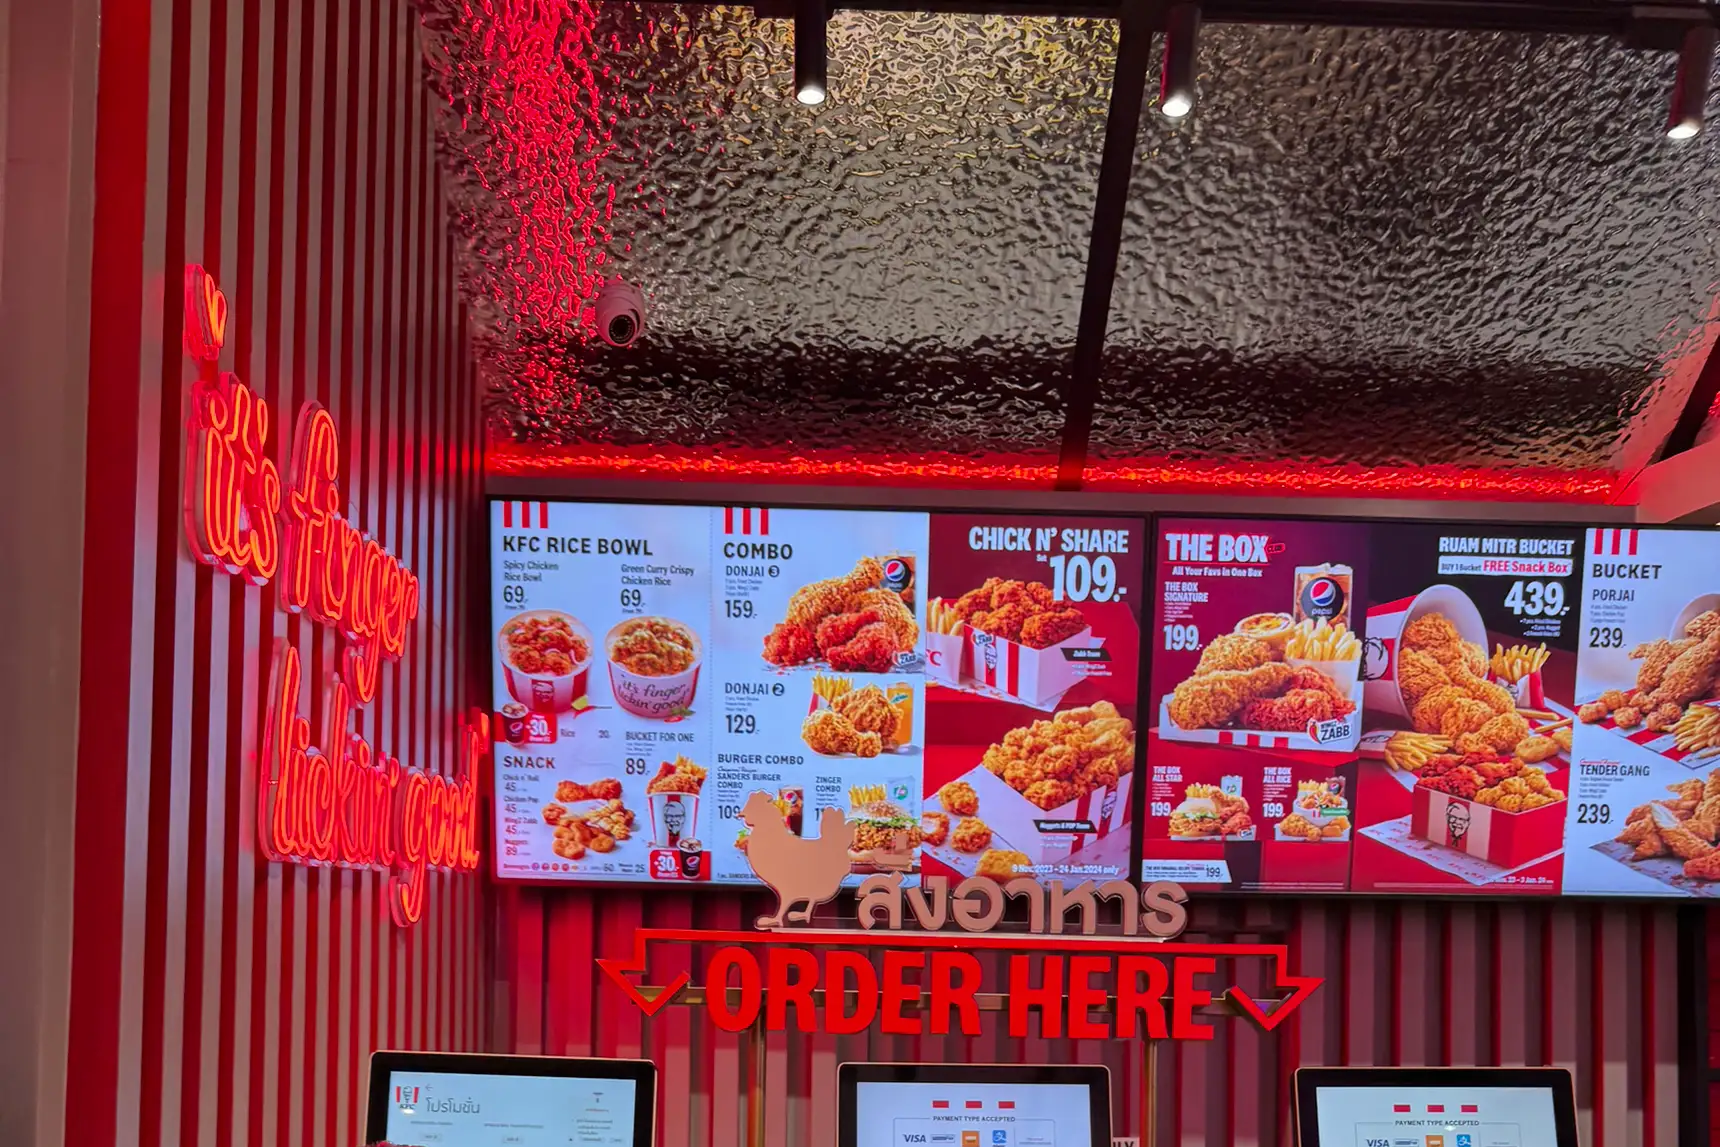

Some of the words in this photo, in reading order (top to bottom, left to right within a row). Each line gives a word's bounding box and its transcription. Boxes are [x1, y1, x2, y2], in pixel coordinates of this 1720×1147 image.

[969, 526, 1031, 551] CHICK
[1061, 529, 1129, 553] SHARE
[503, 536, 540, 552] KFC
[547, 537, 591, 554] RICE
[598, 538, 653, 556] BOWL
[723, 542, 793, 560] COMBO
[1165, 533, 1213, 561] THE
[1218, 534, 1268, 562] BOX
[1439, 537, 1479, 553] RUAM
[1482, 537, 1517, 553] MITR
[1518, 538, 1574, 555] BUCKET
[504, 560, 525, 571] Spicy
[527, 561, 559, 570] Chicken
[621, 564, 644, 573] Green
[646, 565, 667, 575] Curry
[670, 565, 694, 576] Crispy
[725, 565, 764, 577] DONJAI
[1172, 566, 1184, 576] All
[1185, 566, 1203, 576] Your
[1204, 567, 1221, 576] Favs
[1231, 568, 1247, 577] One
[1248, 568, 1262, 577] Box
[1483, 560, 1511, 572] FREE
[1512, 561, 1545, 573] Snack
[1547, 562, 1568, 573] Box
[1592, 563, 1662, 579] BUCKET
[504, 572, 520, 581] Rice
[523, 572, 542, 581] Bowl
[621, 576, 653, 585] Chicken
[654, 577, 671, 585] Rice
[1164, 581, 1180, 591] THE
[1181, 581, 1198, 592] BOX
[1164, 592, 1208, 602] SIGNATURE
[1592, 589, 1635, 601] PORJAI
[725, 682, 769, 695] DONJAI
[626, 731, 657, 740] BUCKET
[659, 732, 676, 741] FOR
[677, 733, 694, 742] ONE
[1321, 725, 1350, 741] ZABB
[503, 756, 555, 769] SNACK
[717, 753, 762, 764] BURGER
[765, 754, 804, 765] COMBO
[1580, 764, 1618, 776] TENDER
[1620, 765, 1650, 776] GANG
[815, 776, 842, 784] ZINGER
[1152, 774, 1165, 782] ALL
[1165, 774, 1183, 782] STAR
[815, 785, 841, 793] COMBO
[706, 946, 983, 1037] ORDER
[1009, 954, 1216, 1041] HERE
[425, 1097, 481, 1114] โปรโมชั่น
[904, 1134, 926, 1143] VISA
[1366, 1138, 1390, 1147] VISA
